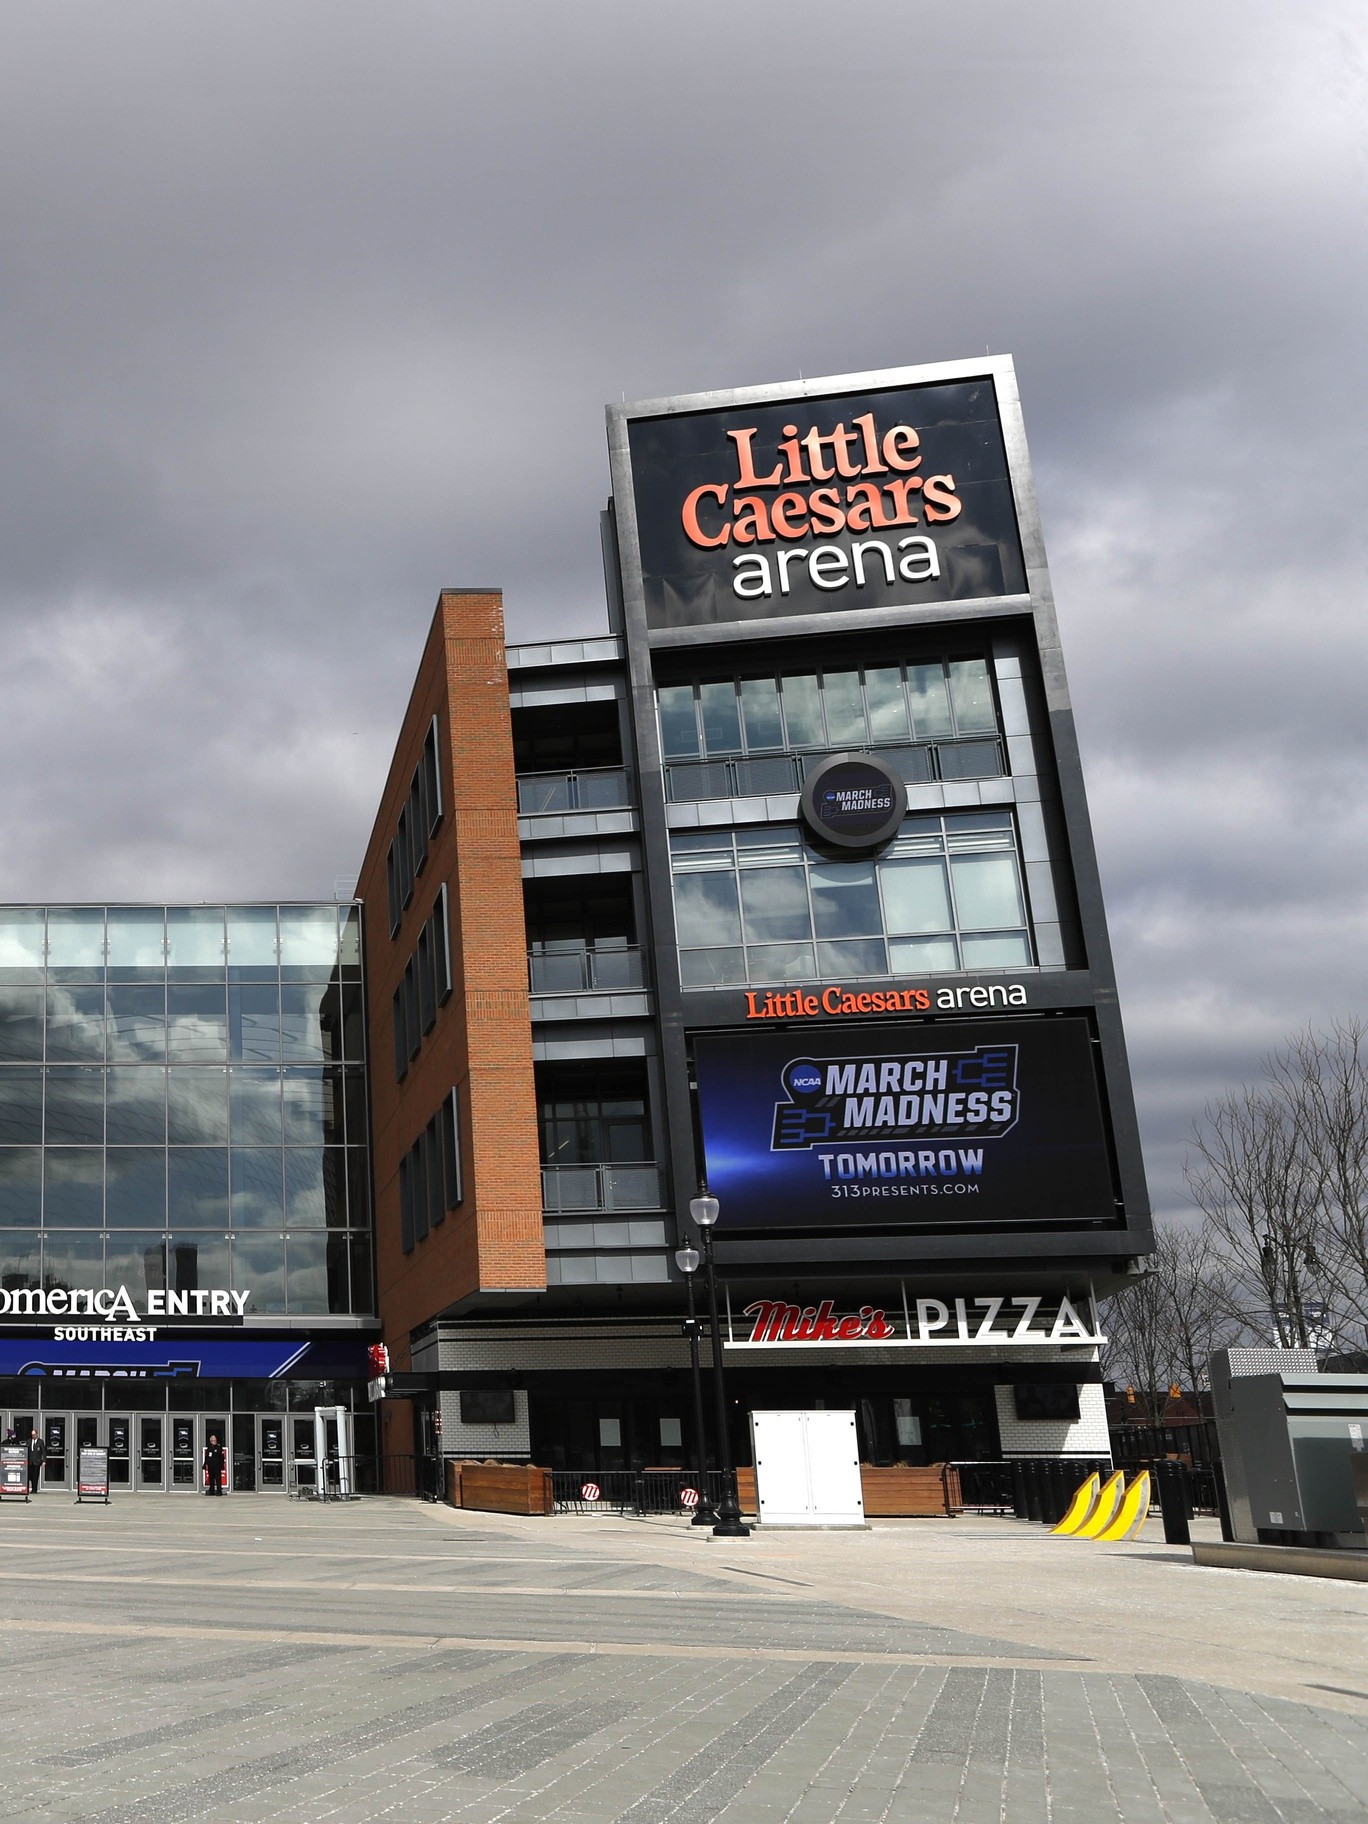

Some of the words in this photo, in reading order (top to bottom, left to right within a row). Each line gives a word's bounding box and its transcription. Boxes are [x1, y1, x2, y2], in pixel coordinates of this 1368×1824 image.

[726, 412, 922, 489] Little
[681, 474, 963, 549] Caesars
[732, 535, 941, 599] arena
[836, 789, 872, 802] MARCH
[841, 798, 891, 811] MADNESS
[744, 989, 819, 1019] Little
[822, 987, 931, 1014] Caesars
[936, 984, 1028, 1009] arena
[793, 1077, 822, 1087] NCAA
[825, 1059, 948, 1095] MARCH
[843, 1091, 1013, 1128] MADNESS
[818, 1149, 984, 1180] TOMORROW
[831, 1184, 980, 1198] 313PRESENTS.COM
[147, 1289, 251, 1316] ENTRY
[743, 1300, 896, 1342] Mike's
[916, 1296, 1093, 1340] PIZZA
[54, 1327, 158, 1342] SOUTHEAST
